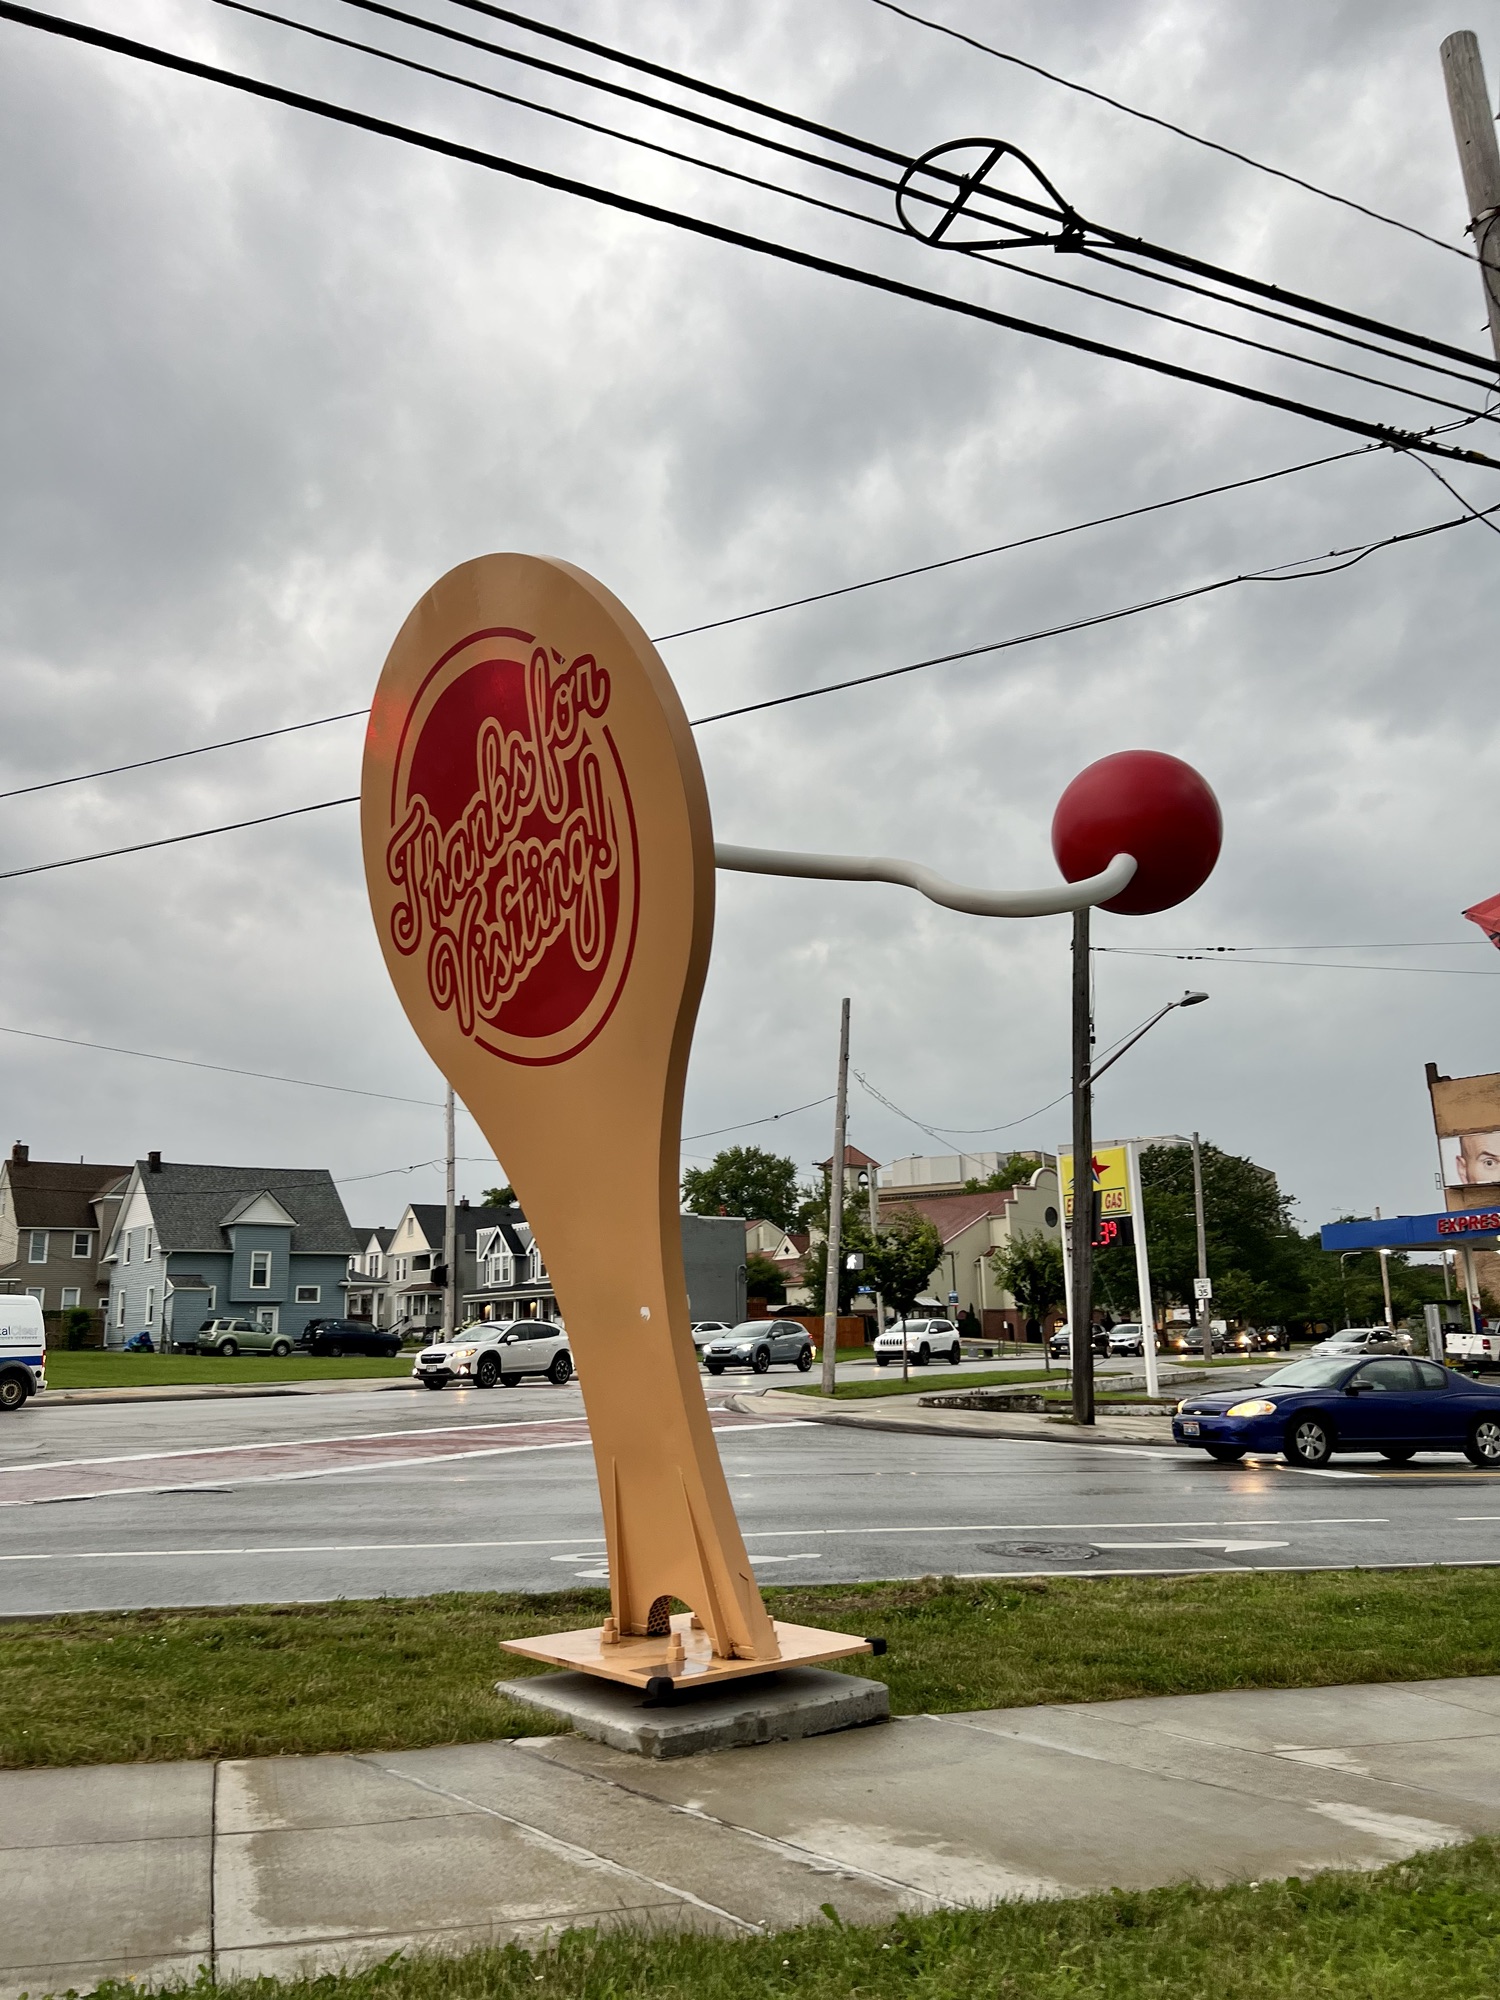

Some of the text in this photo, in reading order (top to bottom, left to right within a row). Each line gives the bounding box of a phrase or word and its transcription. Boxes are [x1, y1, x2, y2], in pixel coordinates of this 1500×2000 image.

[387, 645, 611, 956] Thanks for
[427, 748, 617, 1037] Visiting!
[1104, 1192, 1123, 1209] GAS
[1198, 1288, 1209, 1297] 35
